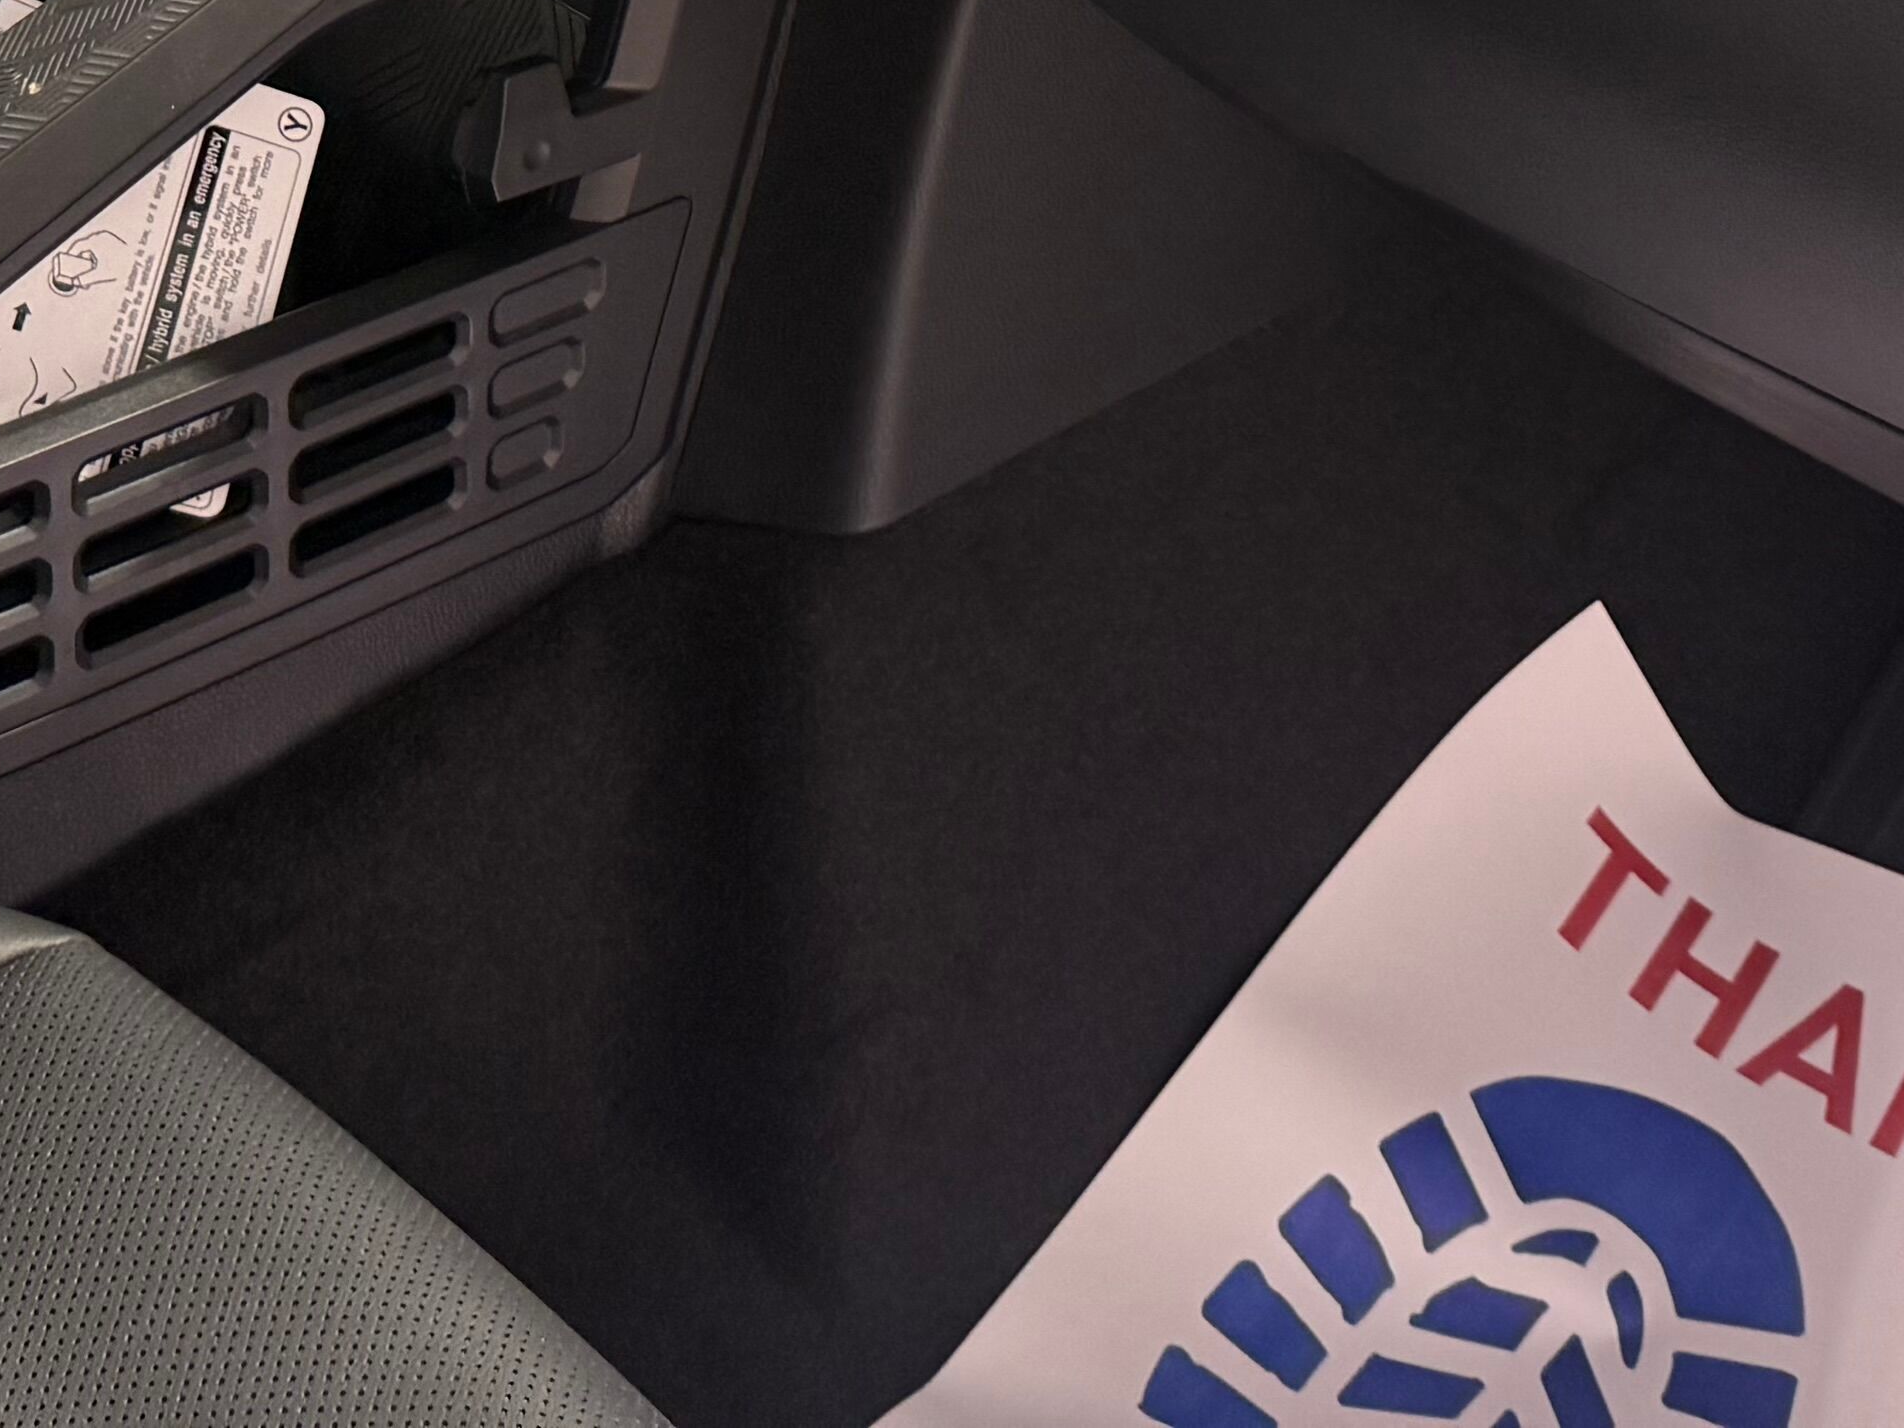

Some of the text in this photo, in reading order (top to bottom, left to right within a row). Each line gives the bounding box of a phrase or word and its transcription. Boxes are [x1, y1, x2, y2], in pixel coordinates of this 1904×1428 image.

[282, 112, 310, 137] Y
[229, 144, 241, 160] an
[190, 131, 227, 206] emergency
[224, 164, 236, 175] in
[184, 209, 202, 229] an
[177, 231, 195, 247] in
[199, 293, 211, 305] is
[218, 200, 241, 240] quickly
[231, 165, 248, 196] press
[199, 225, 219, 260] hybrid
[233, 244, 248, 264] the
[161, 251, 193, 304] system
[226, 268, 242, 293] hold
[146, 306, 178, 354] hybrid
